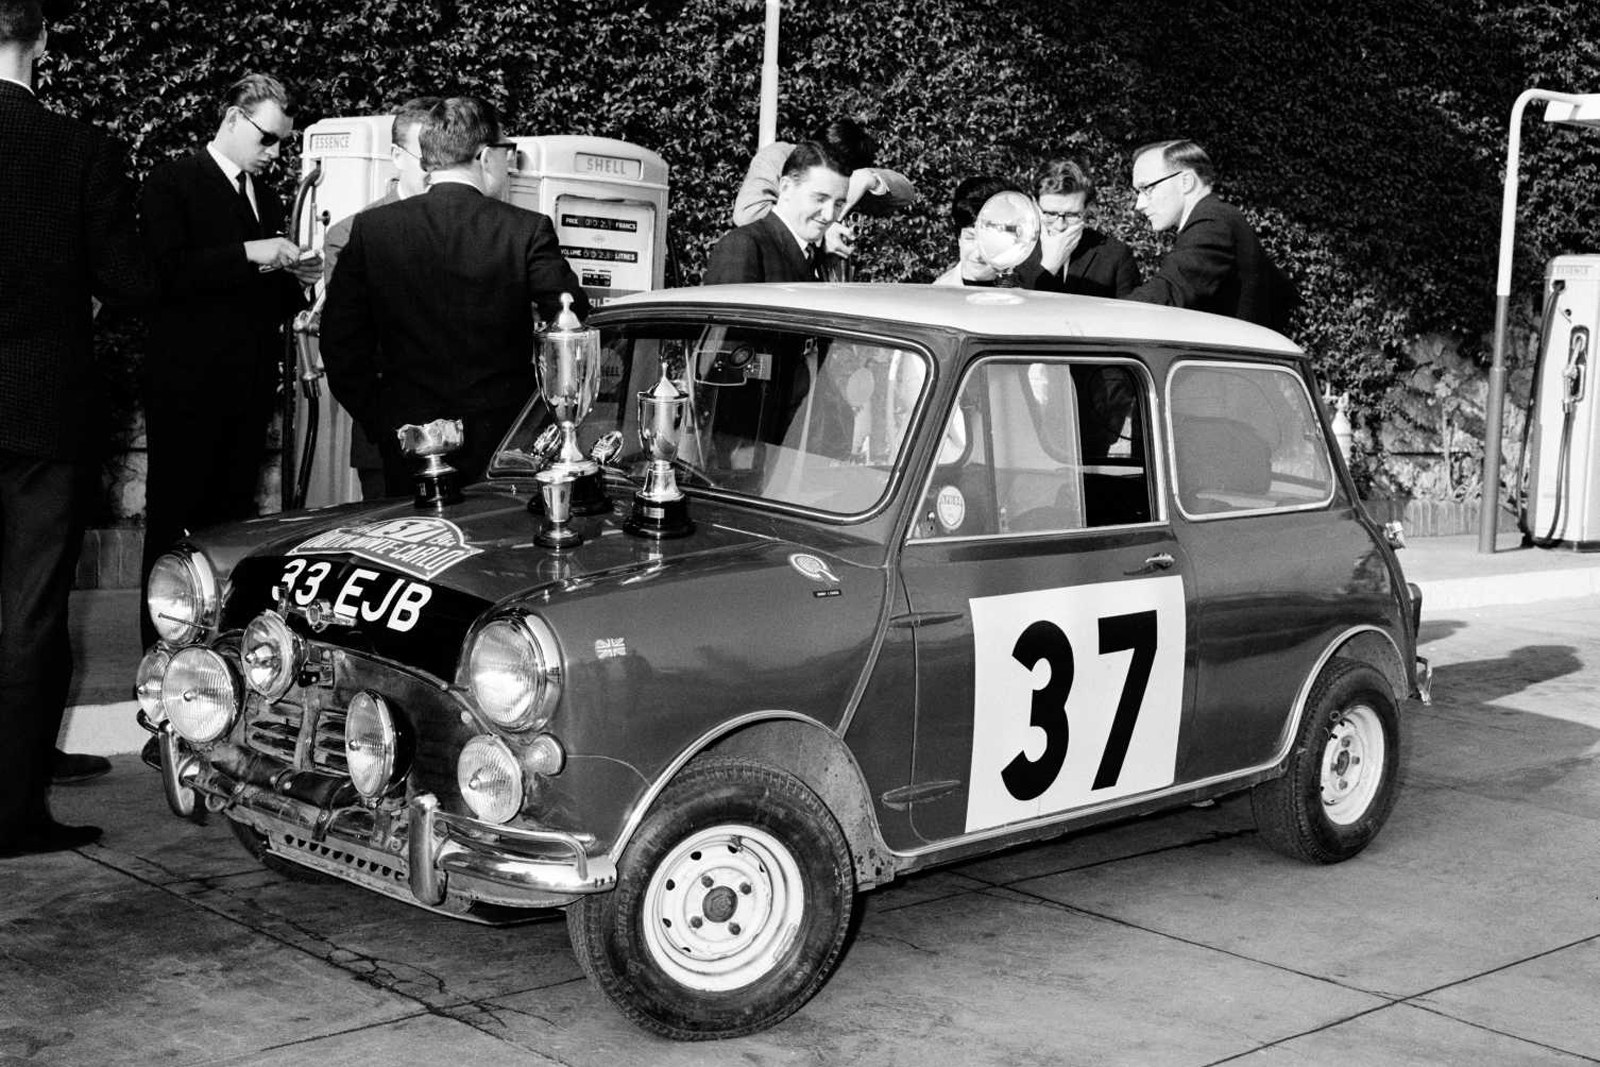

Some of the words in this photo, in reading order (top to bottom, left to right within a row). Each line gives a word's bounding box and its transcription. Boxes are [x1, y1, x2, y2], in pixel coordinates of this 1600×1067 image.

[587, 157, 626, 174] SHELL
[272, 558, 331, 606] 33
[334, 567, 433, 632] EJB
[1000, 609, 1158, 801] 37
